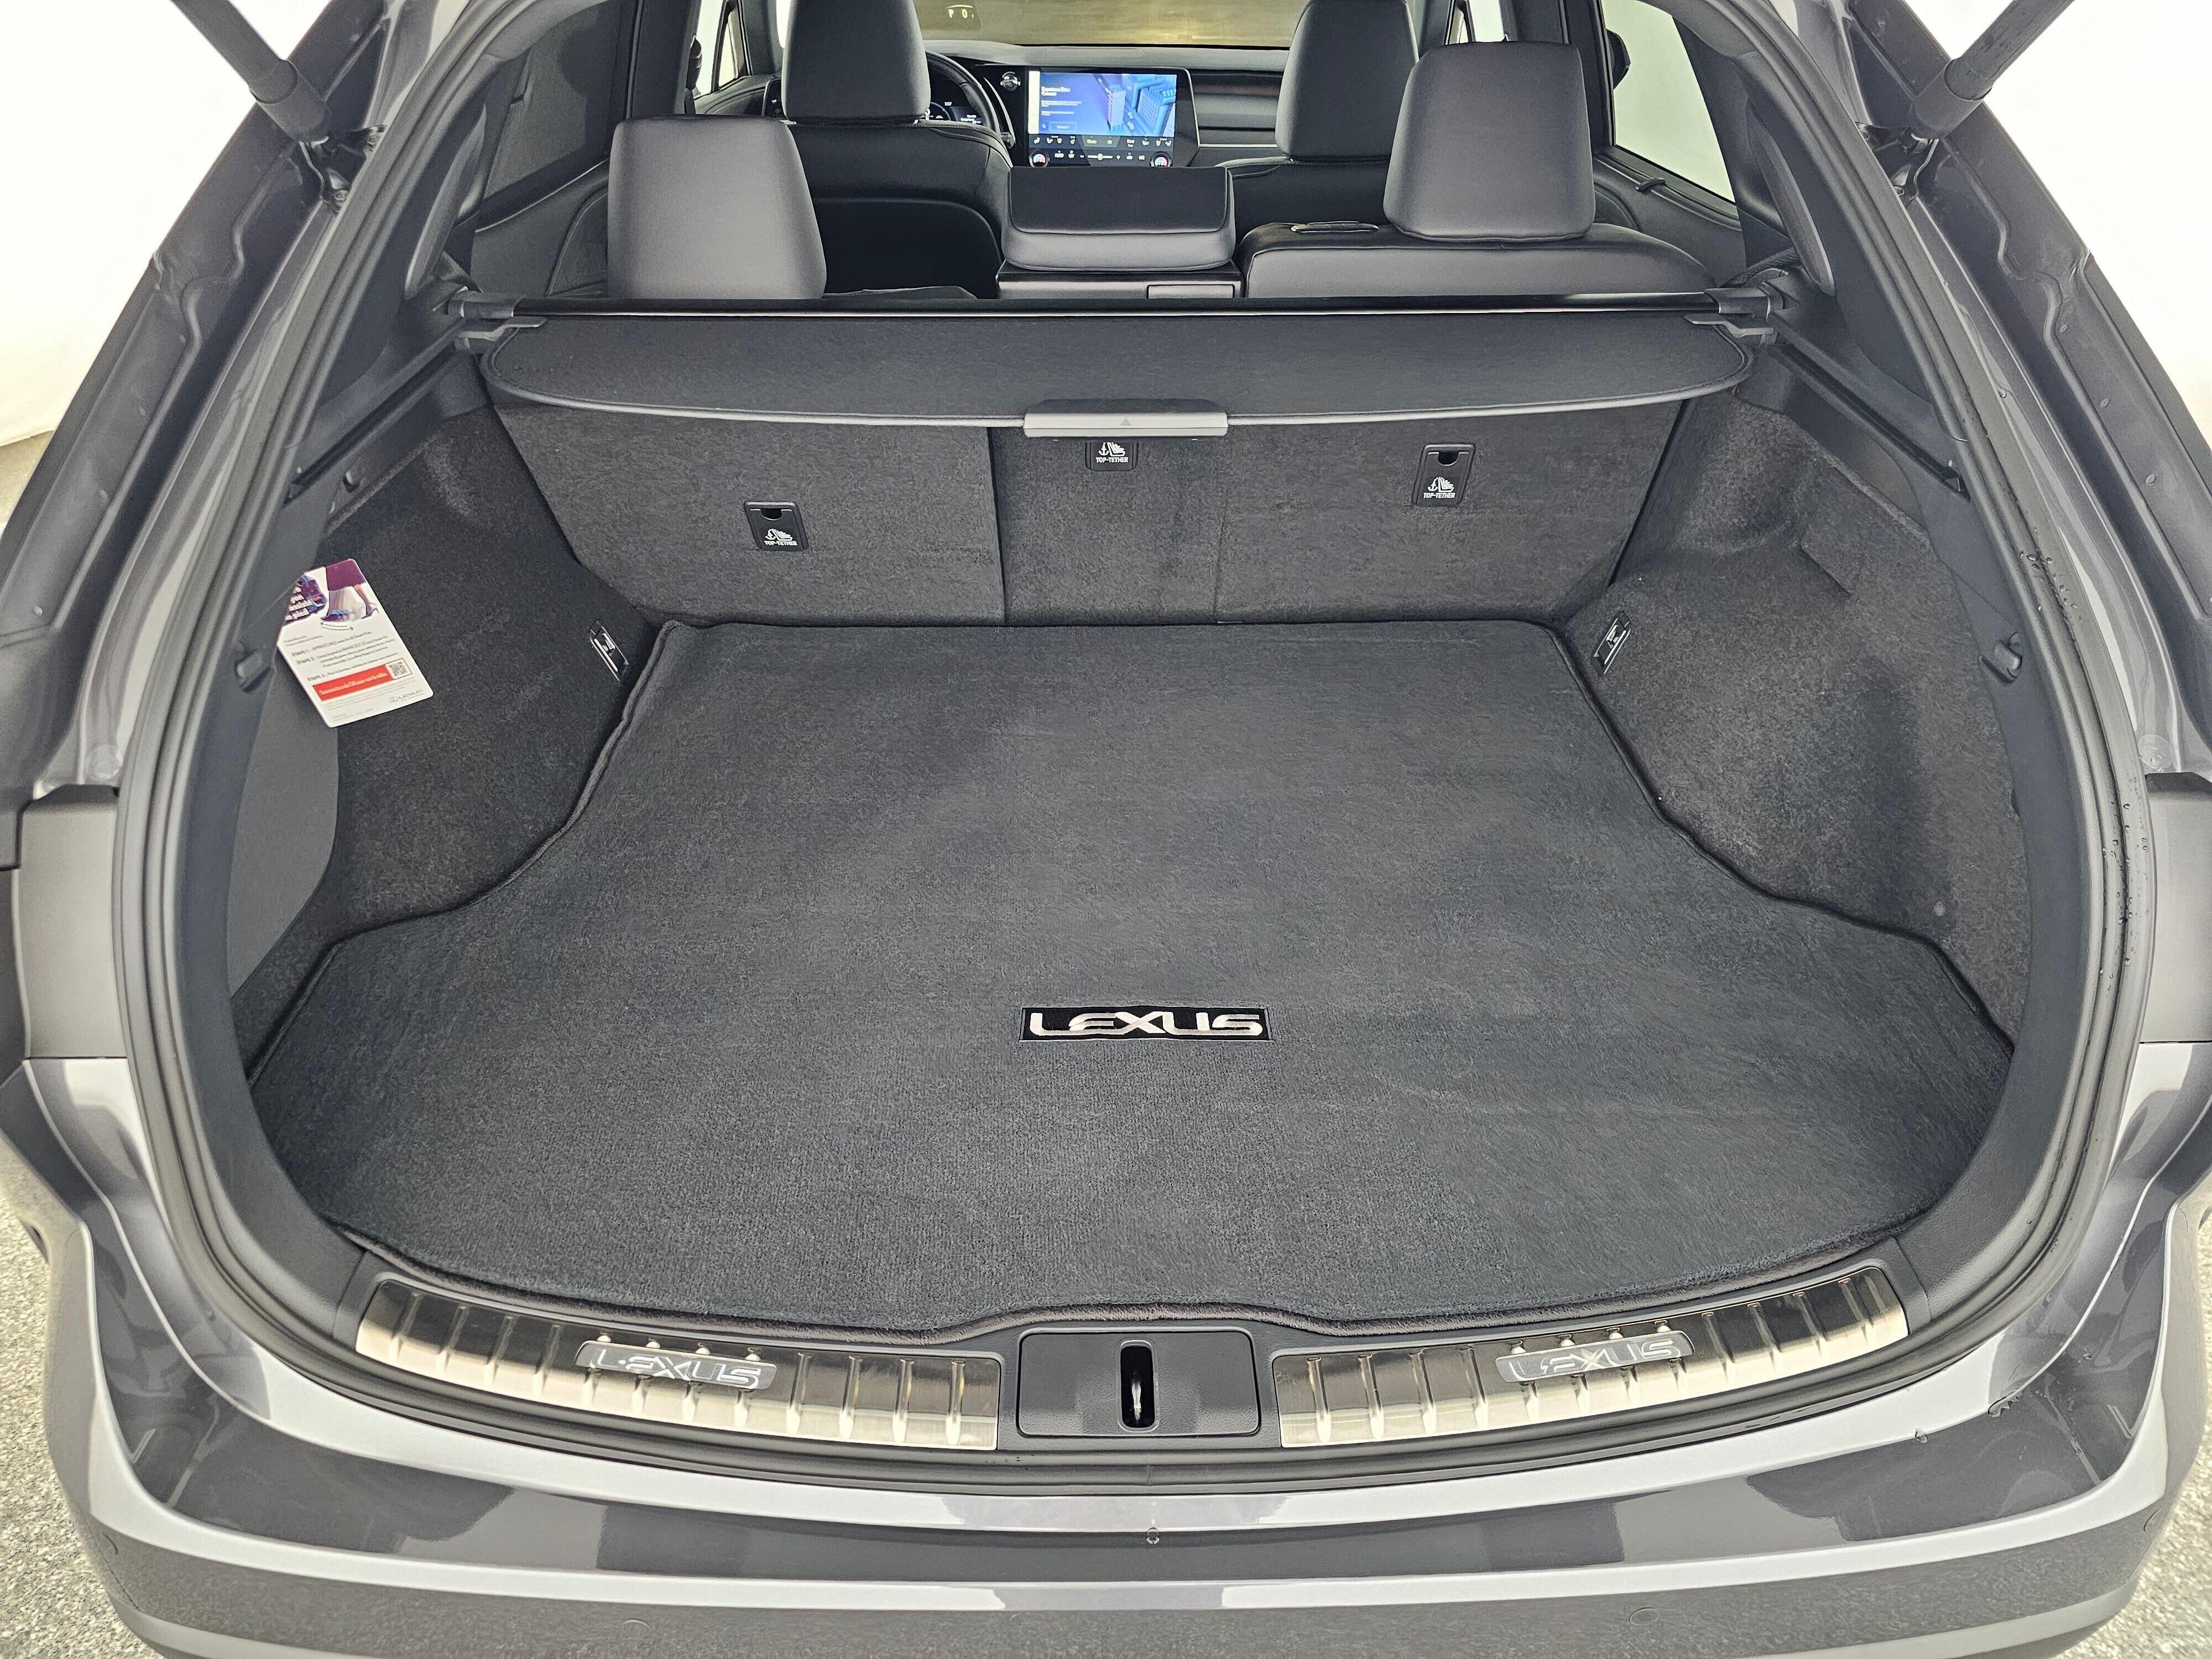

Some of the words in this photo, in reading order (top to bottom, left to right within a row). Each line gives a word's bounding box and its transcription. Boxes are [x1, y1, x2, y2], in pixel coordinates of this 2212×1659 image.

[948, 9, 954, 18] P
[1029, 1011, 1263, 1036] LEXUS
[589, 1348, 761, 1389] LEXUS
[1509, 1338, 1681, 1381] LEXUS
